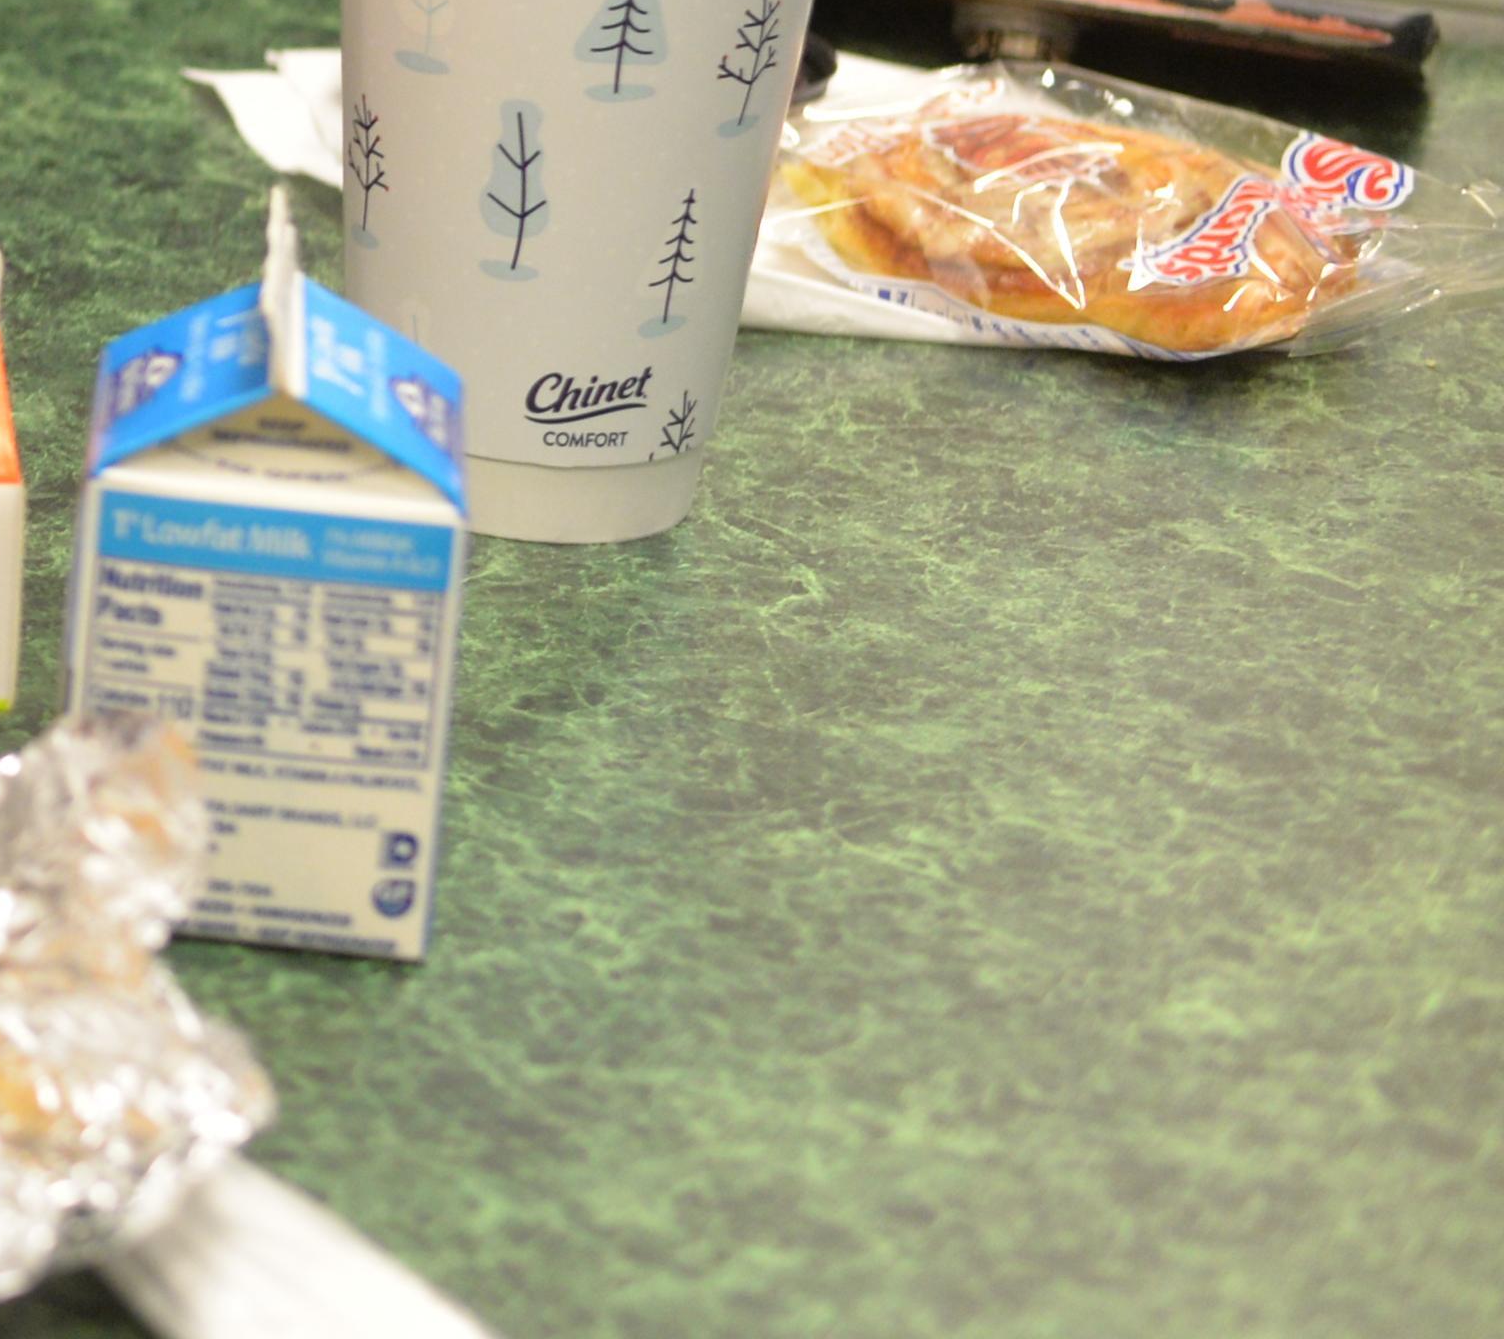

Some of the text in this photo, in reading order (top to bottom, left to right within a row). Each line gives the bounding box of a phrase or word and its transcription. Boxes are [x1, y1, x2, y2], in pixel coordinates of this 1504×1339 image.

[525, 366, 653, 414] Chinet
[543, 431, 629, 448] COMFORT
[140, 518, 242, 553] Lowfat
[248, 525, 312, 560] Milk
[100, 566, 204, 599] Nutrition
[96, 595, 163, 626] Facts
